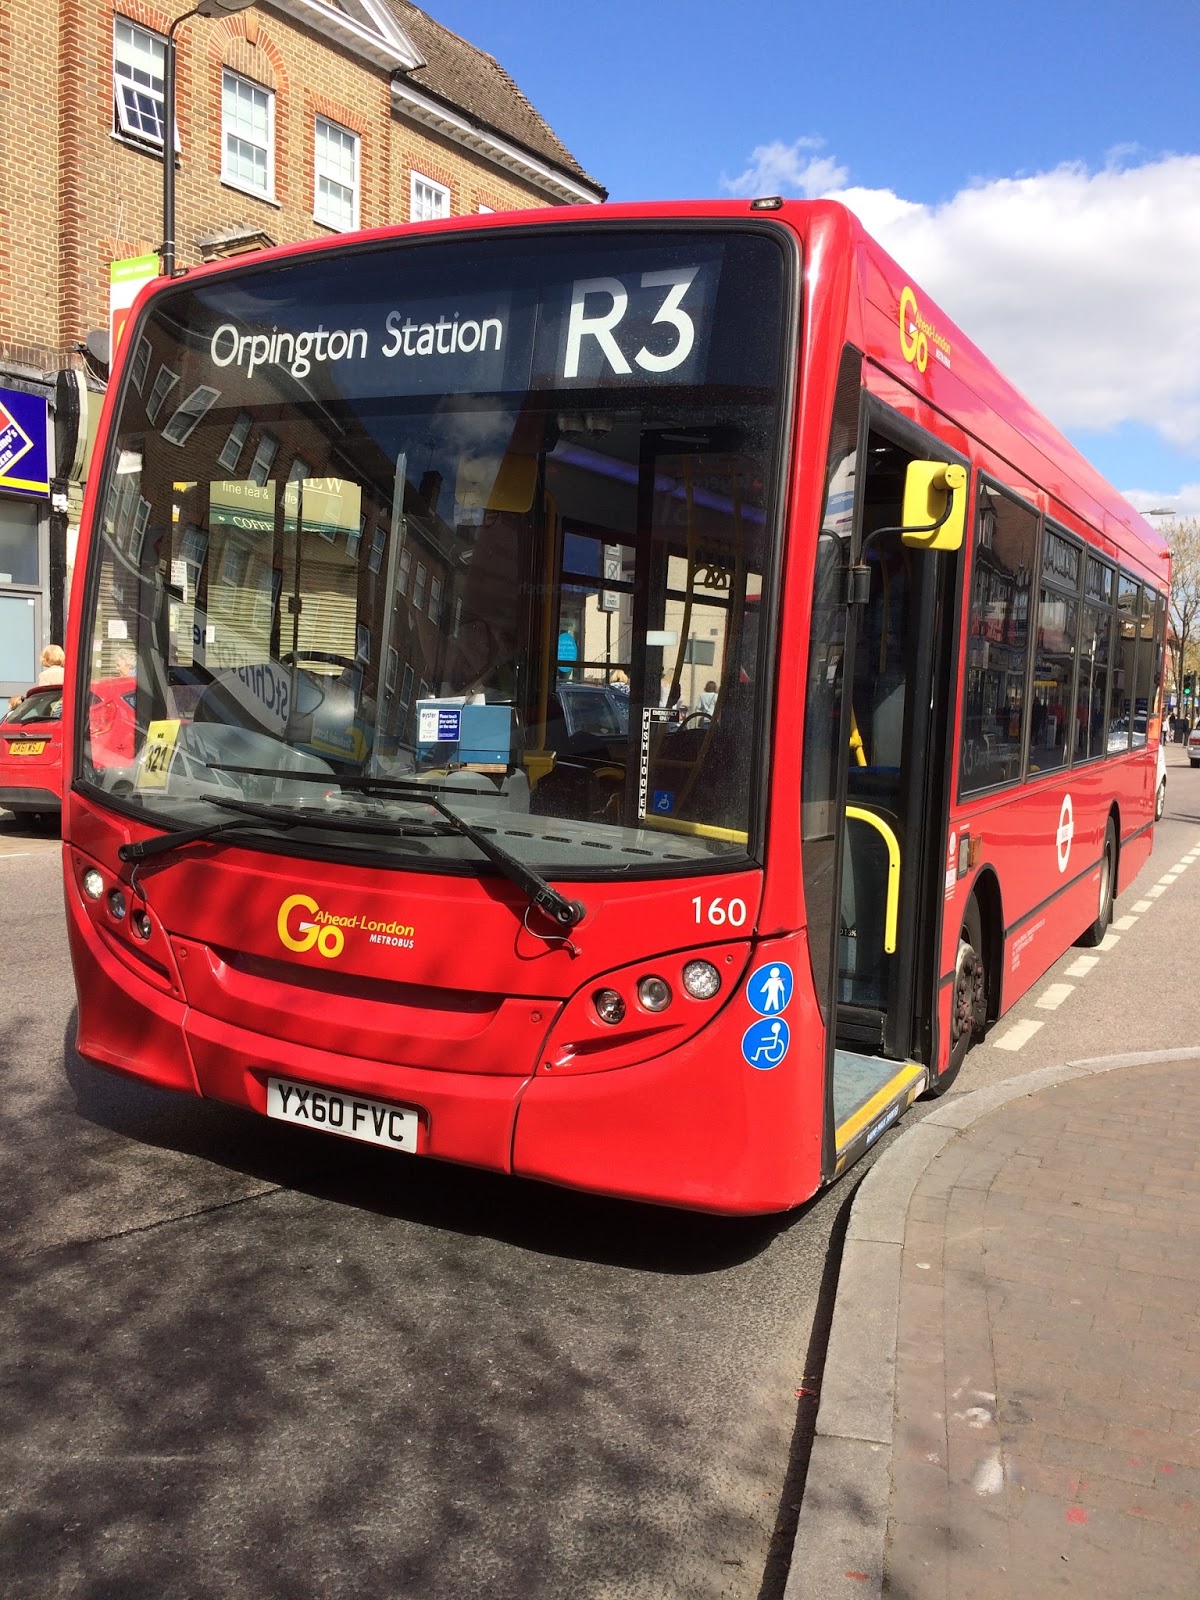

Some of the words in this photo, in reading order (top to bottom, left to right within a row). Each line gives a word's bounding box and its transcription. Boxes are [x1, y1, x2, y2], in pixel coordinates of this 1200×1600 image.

[210, 323, 368, 379] Orpington
[381, 310, 503, 358] Station
[563, 267, 701, 379] R3
[900, 286, 928, 373] Go
[222, 481, 242, 495] fine
[244, 486, 260, 498] tea
[263, 488, 269, 500] &
[232, 516, 274, 531] COFFE
[641, 757, 648, 774] TO
[277, 894, 345, 958] Go
[314, 911, 415, 937] Ahead-London
[691, 897, 747, 926] 160
[369, 933, 415, 949] METROBUS
[278, 1083, 344, 1127] YX60
[352, 1101, 405, 1142] FVC
